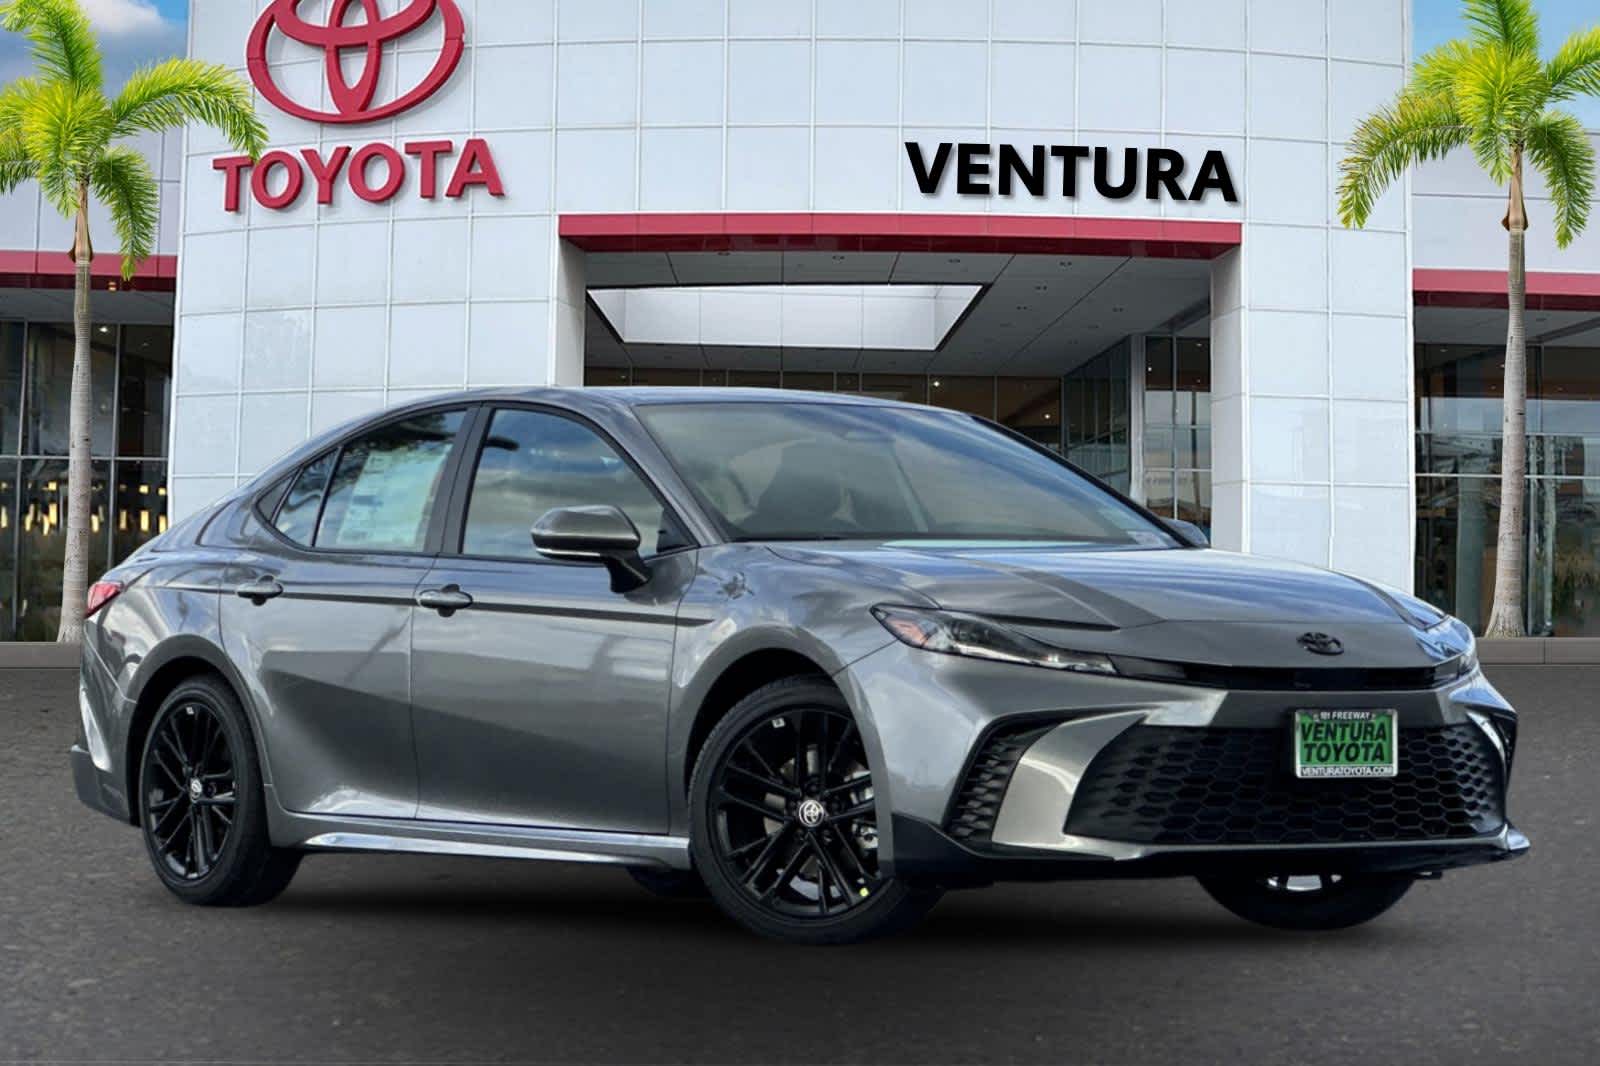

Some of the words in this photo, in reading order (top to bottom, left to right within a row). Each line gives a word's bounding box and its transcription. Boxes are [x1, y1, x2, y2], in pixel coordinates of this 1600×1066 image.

[213, 139, 504, 211] TOYOTA
[905, 142, 1238, 202] VENTURA
[1332, 711, 1370, 720] FREEWAY
[1301, 722, 1386, 741] VENTURA
[1304, 742, 1384, 762] TOYOTA
[1302, 766, 1393, 777] VENTURATOYOTA.COM
